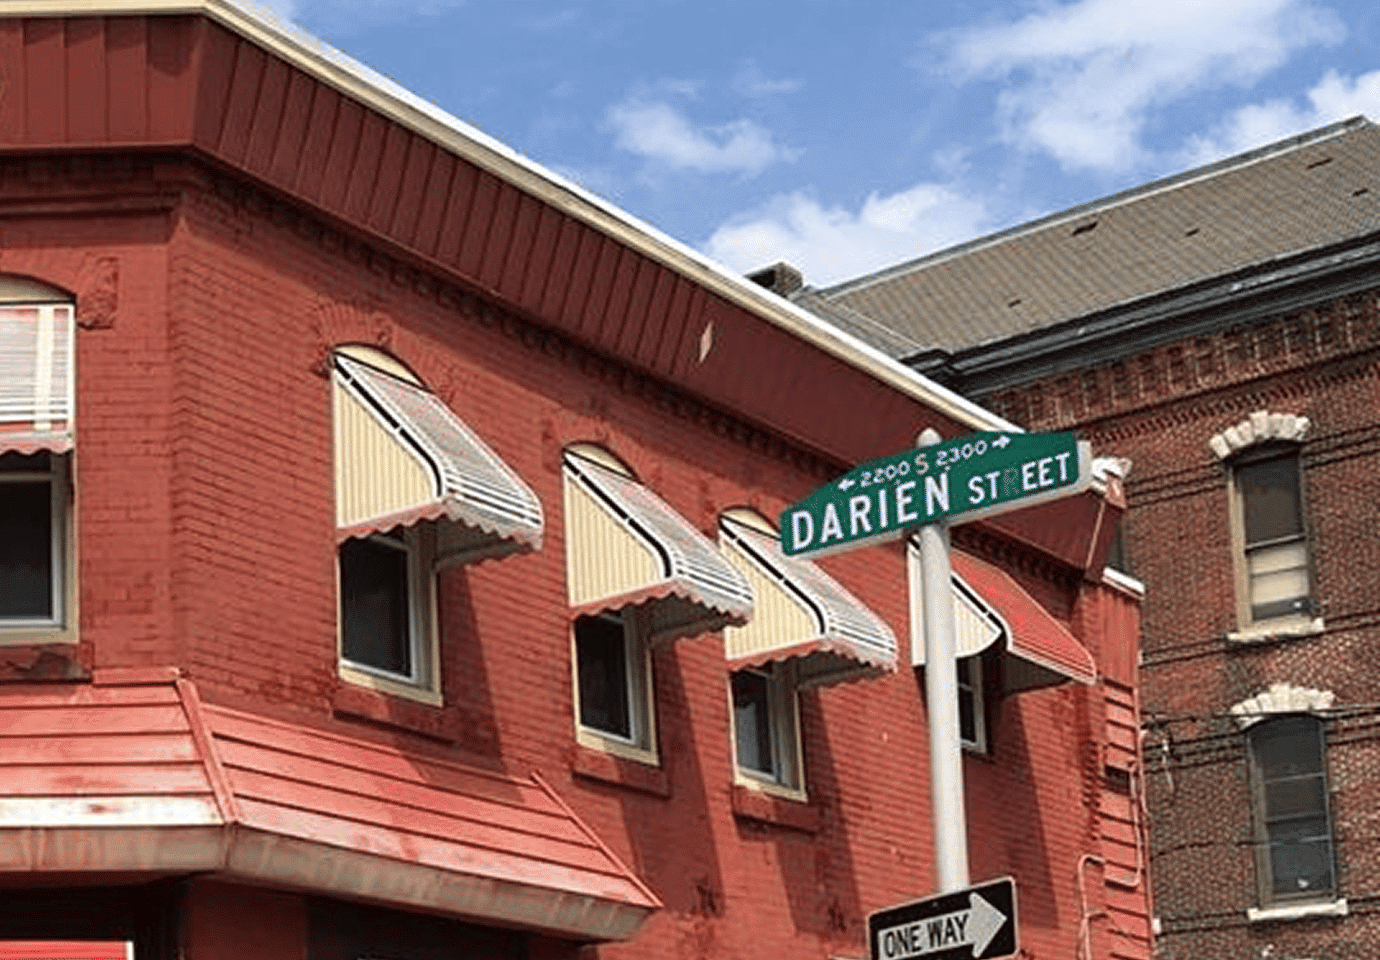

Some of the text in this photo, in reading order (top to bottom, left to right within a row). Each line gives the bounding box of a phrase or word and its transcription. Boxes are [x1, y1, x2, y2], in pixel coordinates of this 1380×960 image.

[860, 440, 988, 487] 2200 S 2300
[791, 472, 950, 550] DARIEN
[883, 913, 969, 958] ONE WAY
